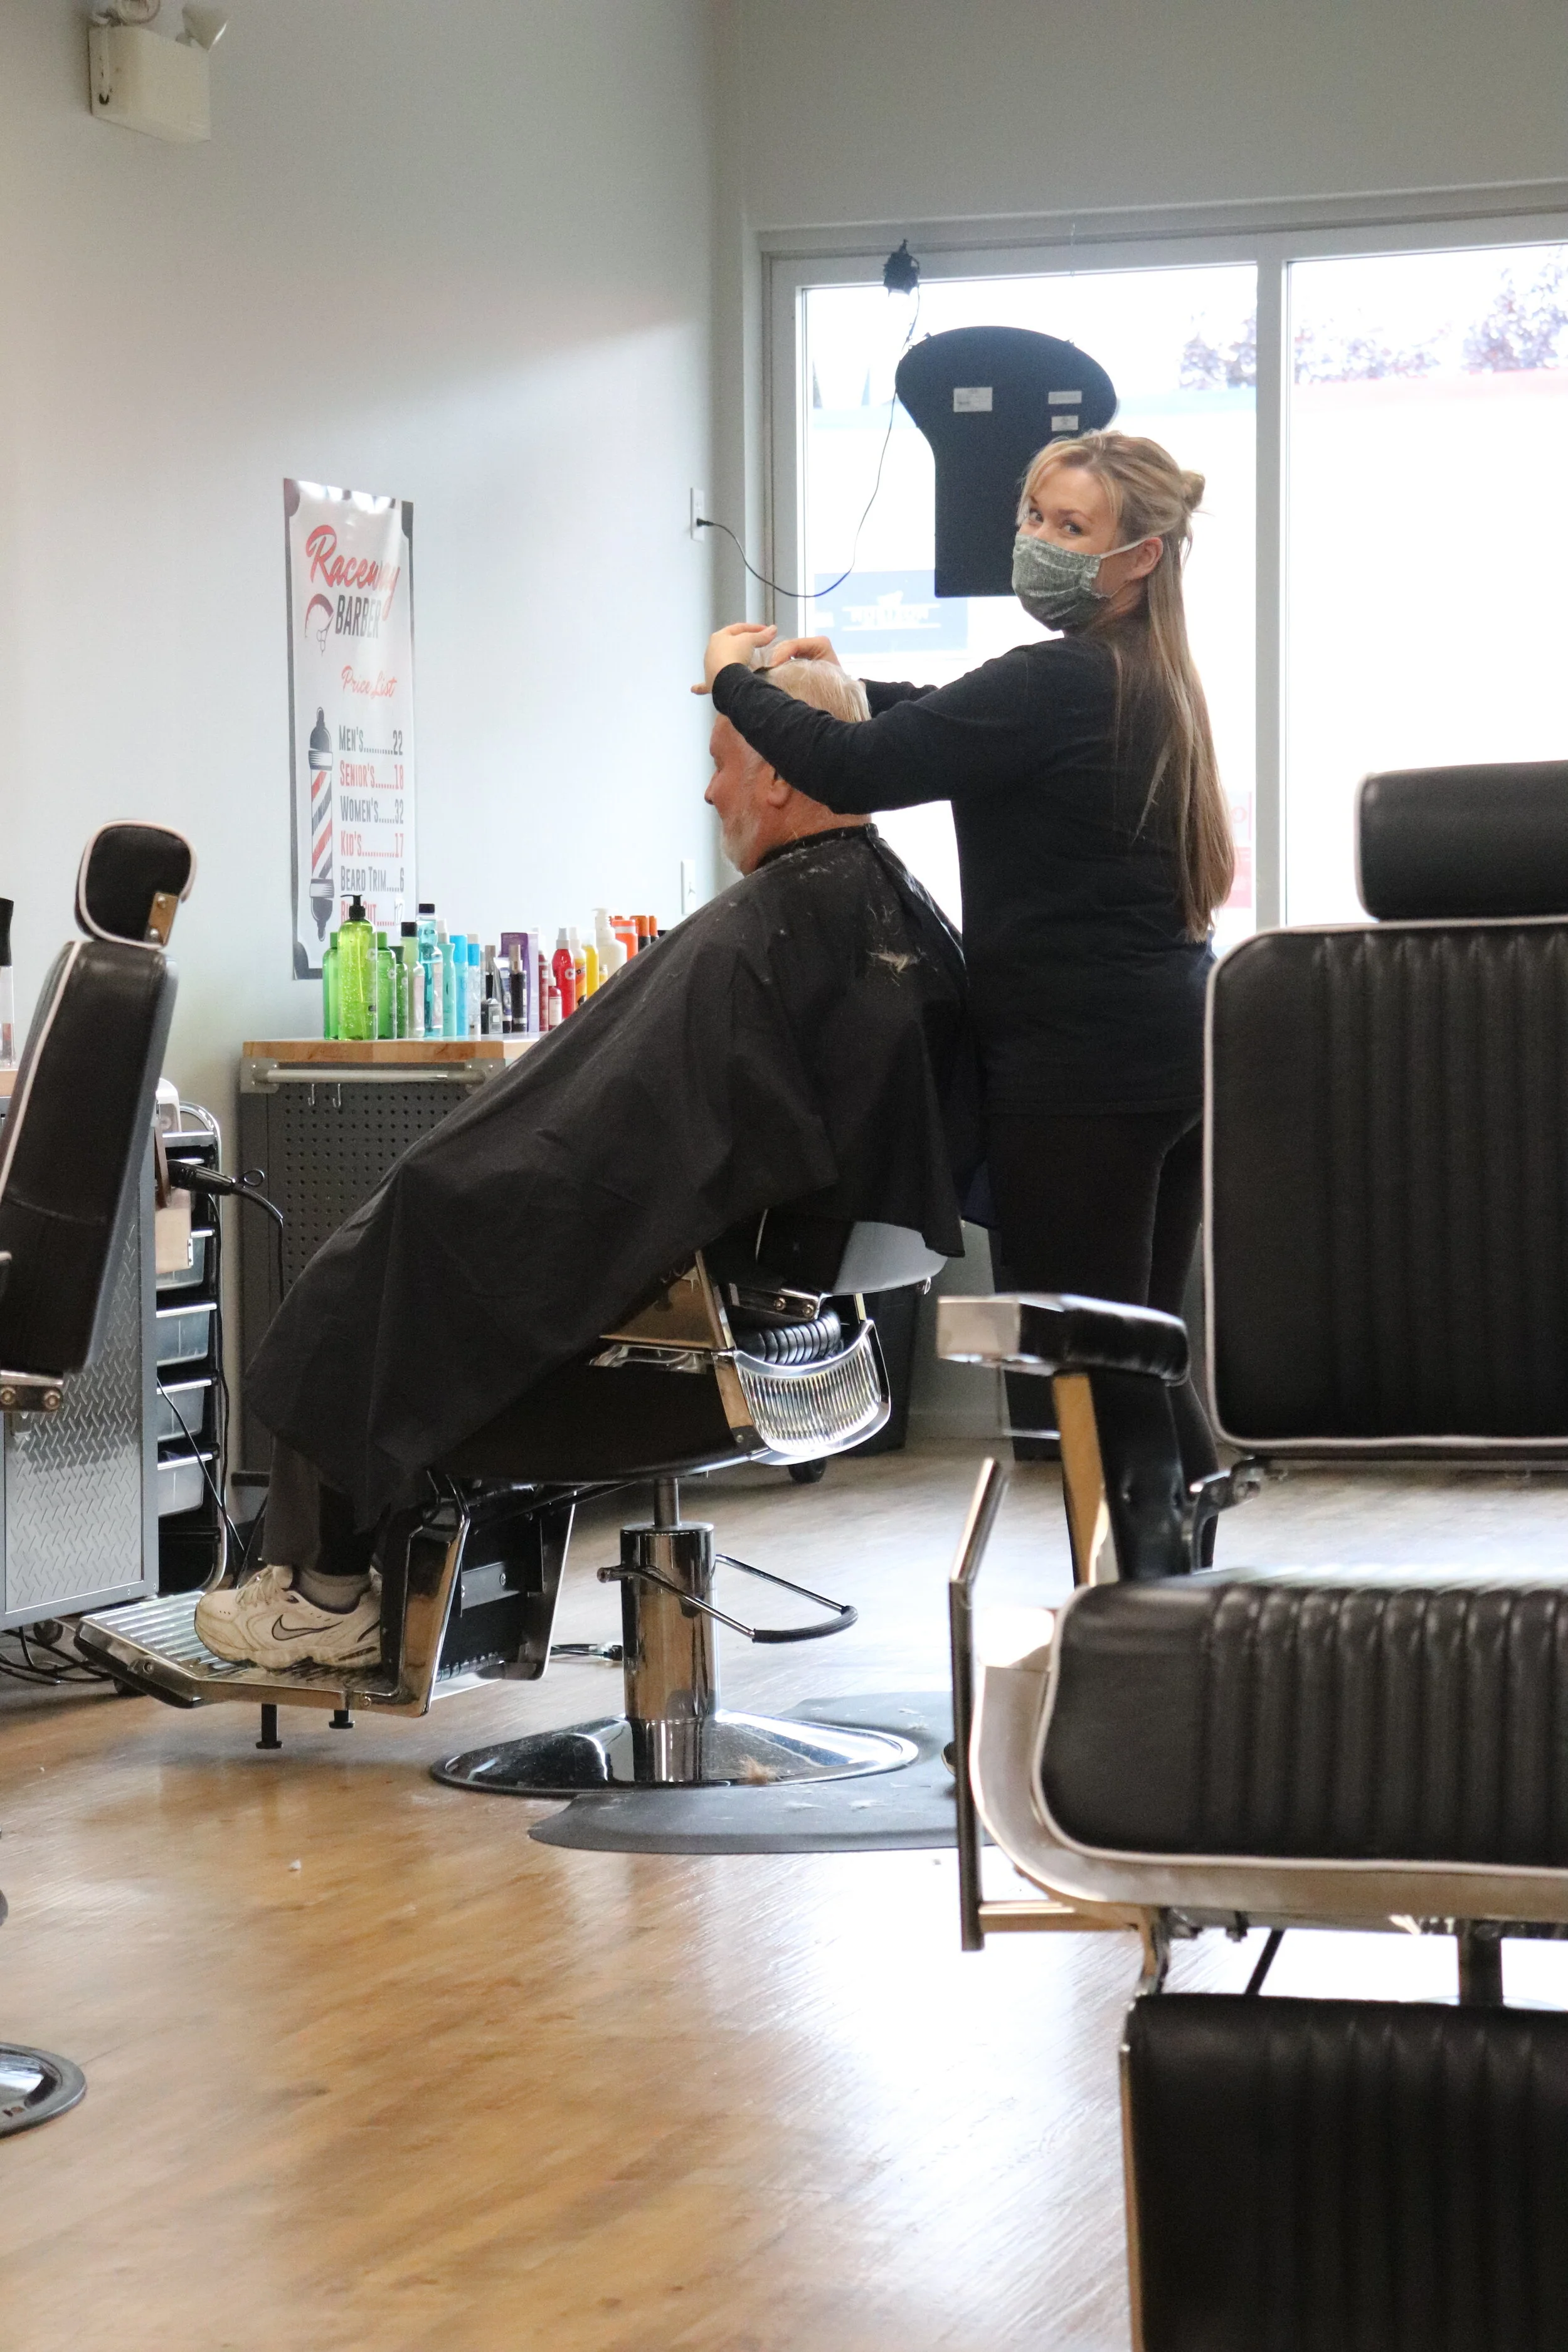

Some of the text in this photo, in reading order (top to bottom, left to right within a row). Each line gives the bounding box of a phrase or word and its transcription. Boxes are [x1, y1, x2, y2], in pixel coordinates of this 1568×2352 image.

[335, 595, 382, 638] BARBER
[341, 665, 398, 699] Price List
[393, 730, 403, 756] 22
[394, 764, 404, 790] 18
[395, 798, 404, 824] 32
[395, 833, 404, 858] 17
[341, 866, 366, 891] BEARD
[369, 866, 386, 892] TRIM
